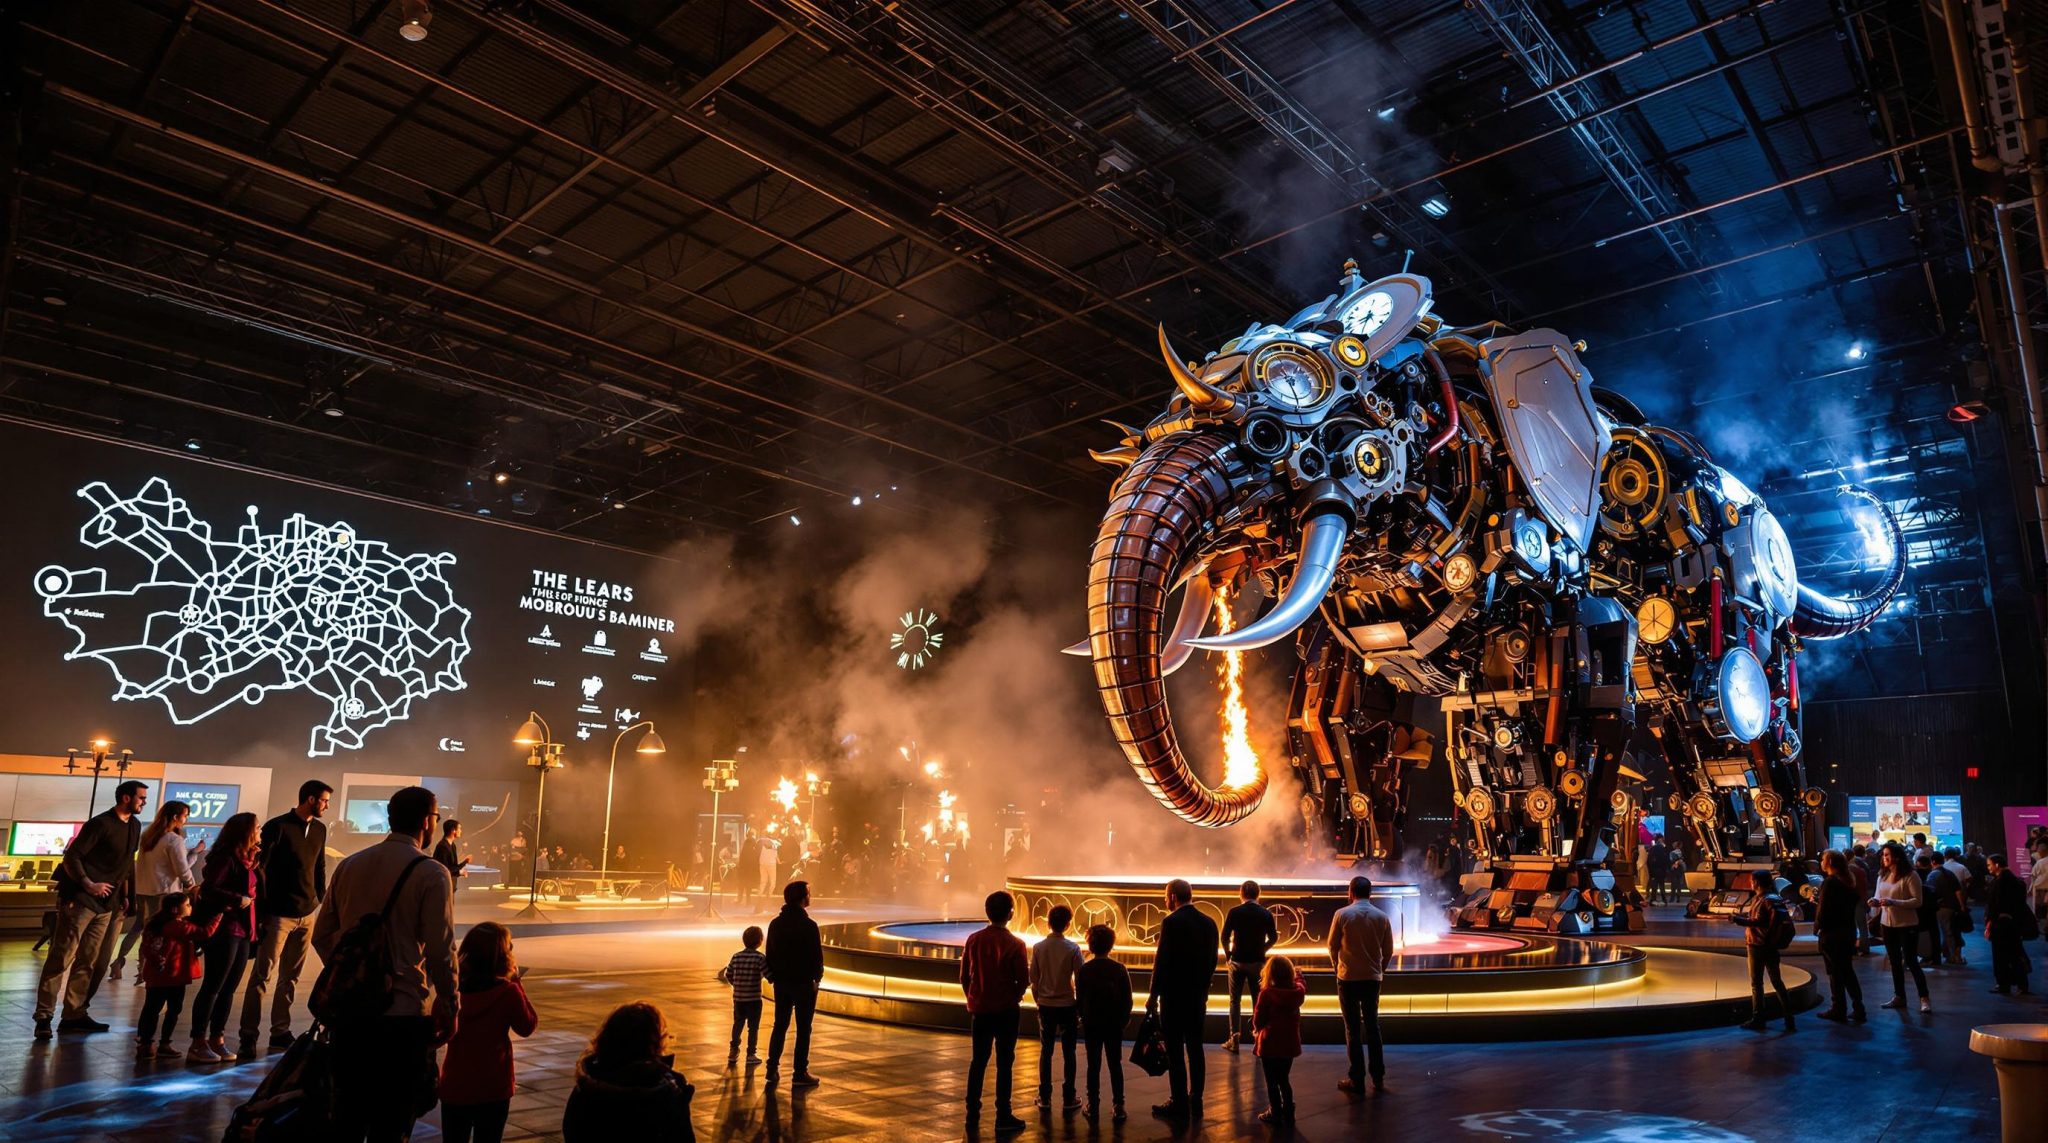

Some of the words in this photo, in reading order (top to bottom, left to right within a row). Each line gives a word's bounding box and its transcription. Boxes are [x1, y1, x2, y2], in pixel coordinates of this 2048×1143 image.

[533, 570, 567, 590] THE
[575, 577, 633, 602] LEARS
[609, 610, 675, 632] BAMINER
[188, 799, 226, 818] 017
